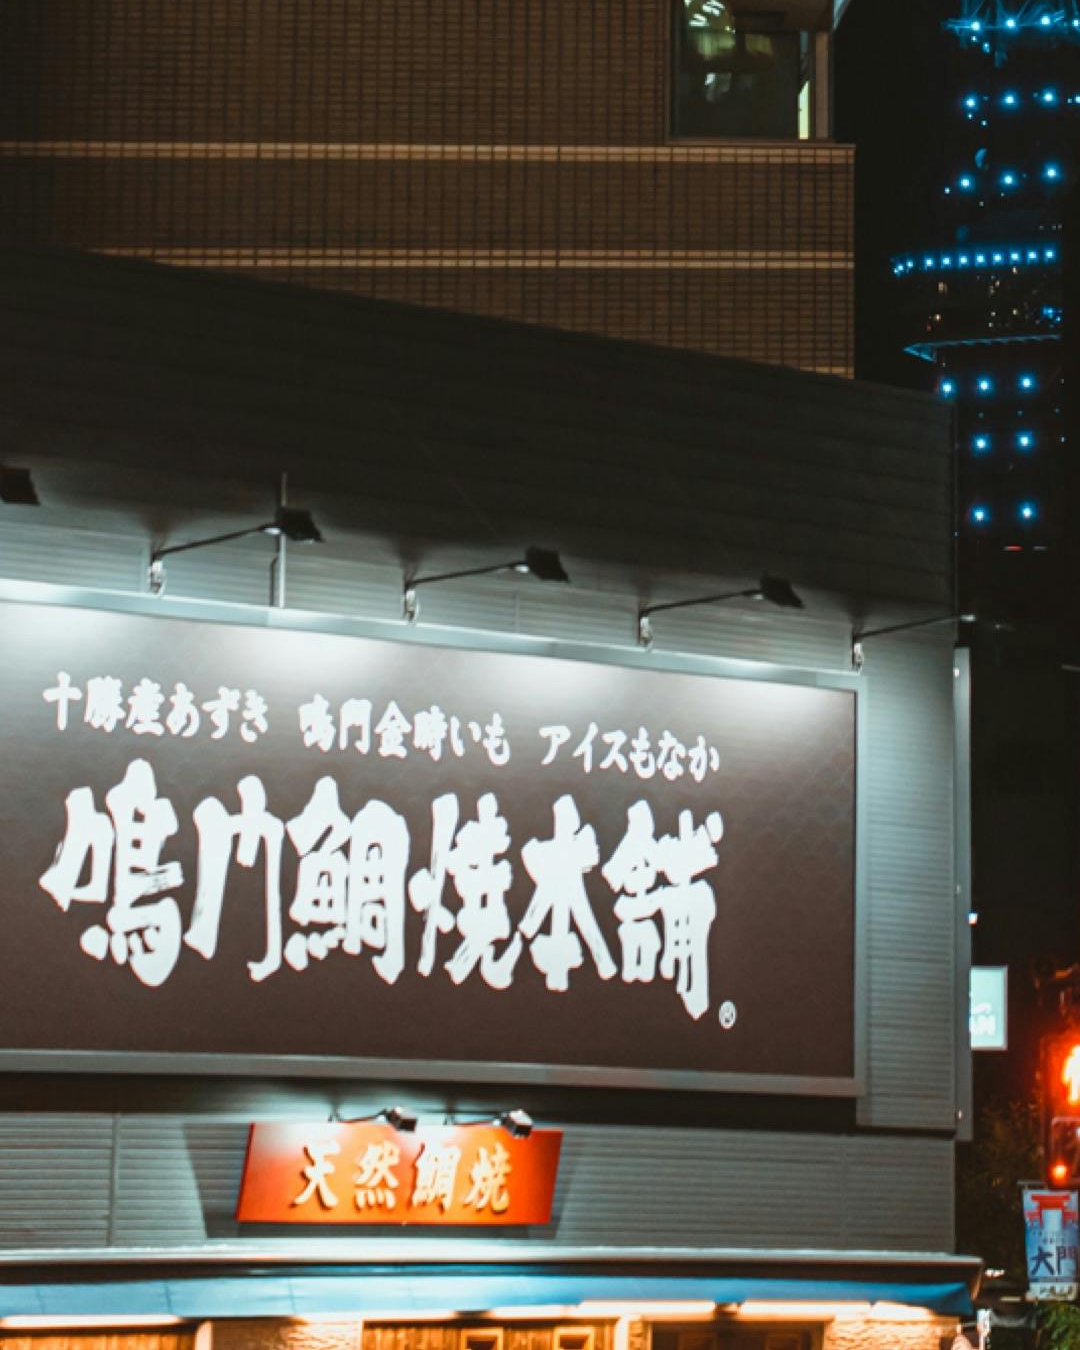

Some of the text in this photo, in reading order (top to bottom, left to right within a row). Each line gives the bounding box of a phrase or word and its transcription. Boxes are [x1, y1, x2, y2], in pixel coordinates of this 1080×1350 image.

[42, 671, 720, 782] 十勝産あずき 鳴門金時いも アイスもなか
[39, 757, 725, 1020] 鳴門鯛焼本舗
[294, 1140, 512, 1213] 天然鯛焼
